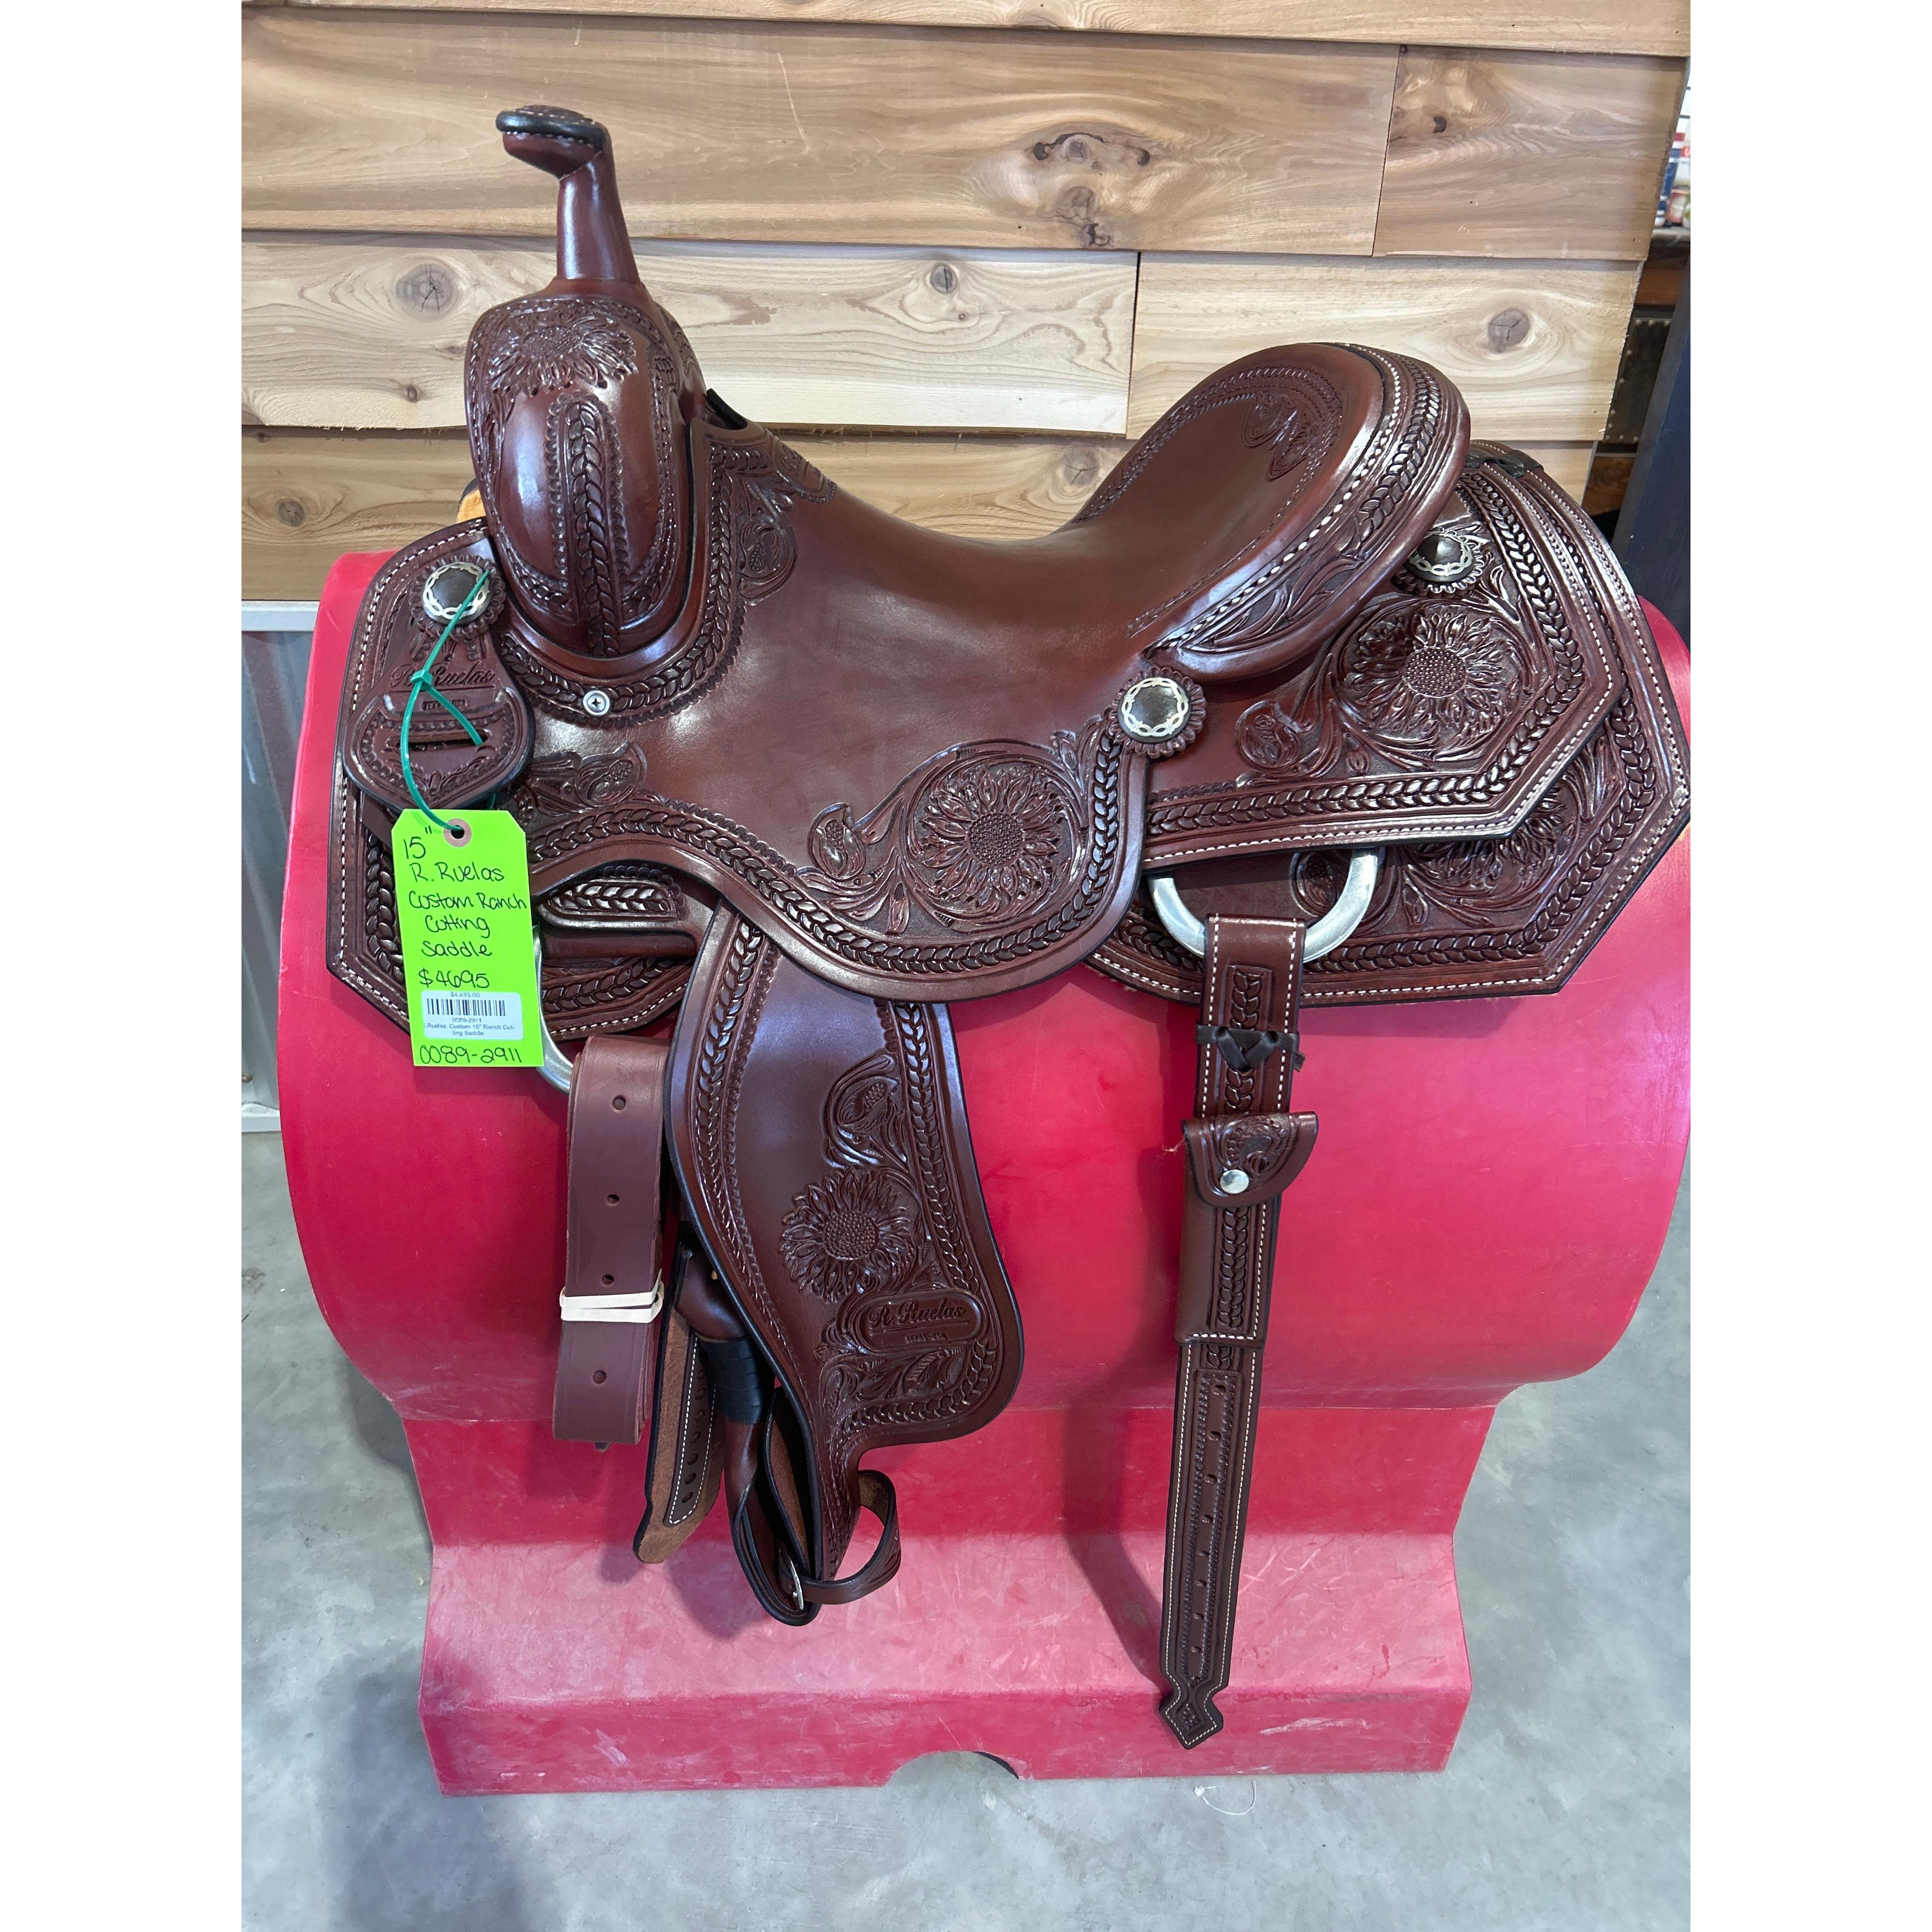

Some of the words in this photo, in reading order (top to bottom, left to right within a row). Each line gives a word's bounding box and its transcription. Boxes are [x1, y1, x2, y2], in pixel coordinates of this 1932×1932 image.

[409, 891, 474, 910] Custom
[476, 892, 527, 910] Ranch
[425, 915, 490, 938] Cutting
[421, 940, 493, 957] Saddle
[419, 967, 490, 989] $4695
[420, 1045, 522, 1065] 0089-2911
